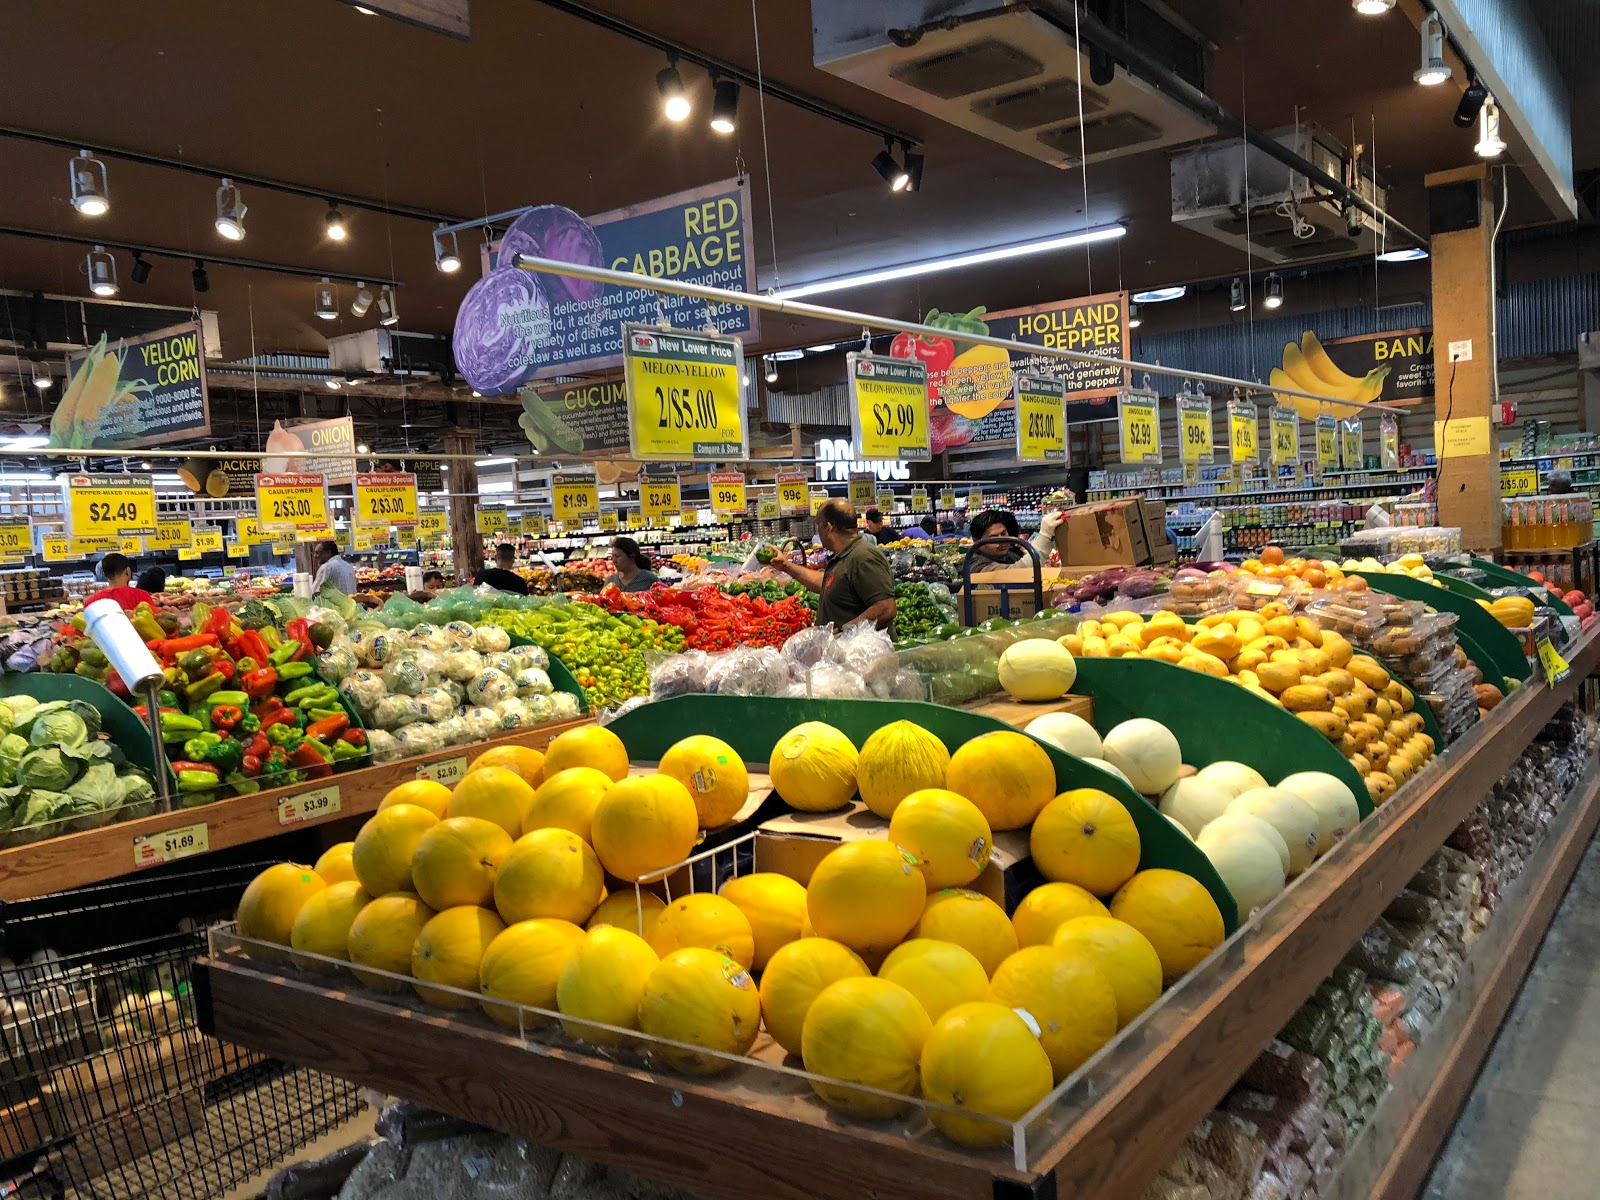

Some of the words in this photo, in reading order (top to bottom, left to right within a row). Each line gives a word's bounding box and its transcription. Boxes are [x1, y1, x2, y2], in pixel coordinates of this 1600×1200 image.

[684, 198, 738, 238] RED
[499, 309, 550, 327] Nutritious,
[553, 298, 600, 316] delicious
[602, 290, 623, 306] and
[514, 325, 533, 338] the
[534, 319, 566, 334] world,
[568, 318, 575, 328] it
[577, 312, 601, 326] adds
[604, 306, 634, 321] flavor
[1019, 303, 1119, 336] HOLLAND
[530, 335, 566, 349] variety
[568, 331, 579, 343] of
[581, 325, 617, 341] dishes.
[674, 310, 691, 323] for
[1044, 324, 1120, 350] PEPPER
[140, 333, 197, 367] YELLOW
[508, 351, 550, 368] coleslaw
[553, 351, 563, 360] as
[566, 343, 587, 358] well
[590, 345, 601, 354] as
[659, 338, 679, 353] New
[682, 340, 708, 355] Lower
[711, 344, 732, 358] Price
[1088, 346, 1120, 356] colors:
[1375, 335, 1434, 360] BANA
[157, 358, 199, 386] CORN
[642, 361, 726, 379] MELON-YELLOW
[875, 364, 888, 375] New
[890, 366, 907, 377] Lower
[909, 368, 924, 379] Price
[941, 367, 956, 377] bell
[958, 364, 992, 375] peppers
[1398, 372, 1424, 381] sweet,
[930, 379, 945, 388] red,
[948, 376, 974, 386] green,
[976, 372, 1005, 382] yellow,
[937, 387, 951, 396] The
[953, 383, 989, 394] sweetest
[1058, 371, 1074, 380] and
[1077, 366, 1121, 381] generally
[1396, 379, 1427, 389] favorite
[564, 383, 628, 411] CUCUM
[859, 383, 922, 396] MELON-HONEYDEW
[929, 398, 942, 406] the
[944, 395, 971, 405] lighter
[972, 392, 986, 401] the
[988, 391, 1012, 399] color,
[1068, 380, 1082, 390] the
[1085, 377, 1121, 389] pepper.
[172, 403, 184, 411] and
[185, 400, 203, 409] eaten
[1022, 394, 1061, 406] MANGO-ATAULFO
[655, 386, 718, 432] 2/$5.00
[171, 411, 204, 424] worldwide.
[873, 402, 914, 438] $2.99
[721, 429, 735, 438] FOR
[1028, 411, 1055, 441] 2/$3.00
[1130, 422, 1151, 446] $2.99
[311, 425, 350, 446] ONION
[1188, 425, 1206, 448] 99¢
[697, 444, 721, 455] Compare
[726, 445, 739, 454] Save
[217, 460, 260, 471] JACKFR
[414, 461, 440, 471] APPLE
[820, 439, 910, 480] PRUCE
[92, 477, 108, 485] New
[132, 477, 150, 485] Price
[275, 476, 298, 485] Weekly
[299, 476, 322, 485] Special
[372, 476, 391, 484] Weekly
[392, 475, 414, 484] Special
[1500, 478, 1528, 490] 2/$5.00
[563, 494, 588, 508] $1.99
[649, 493, 671, 507] $2.49
[719, 491, 738, 505] 99¢
[783, 489, 801, 502] 99¢
[90, 502, 137, 524] $2.49
[274, 499, 311, 519] 2/$3.00
[371, 498, 405, 515] 2/$3.00
[421, 518, 439, 529] $2.99
[484, 516, 502, 526] $1.29
[196, 538, 214, 547] $1.99
[437, 766, 457, 779] $2.99
[304, 797, 328, 812] $3.99
[165, 835, 193, 852] $1.69
